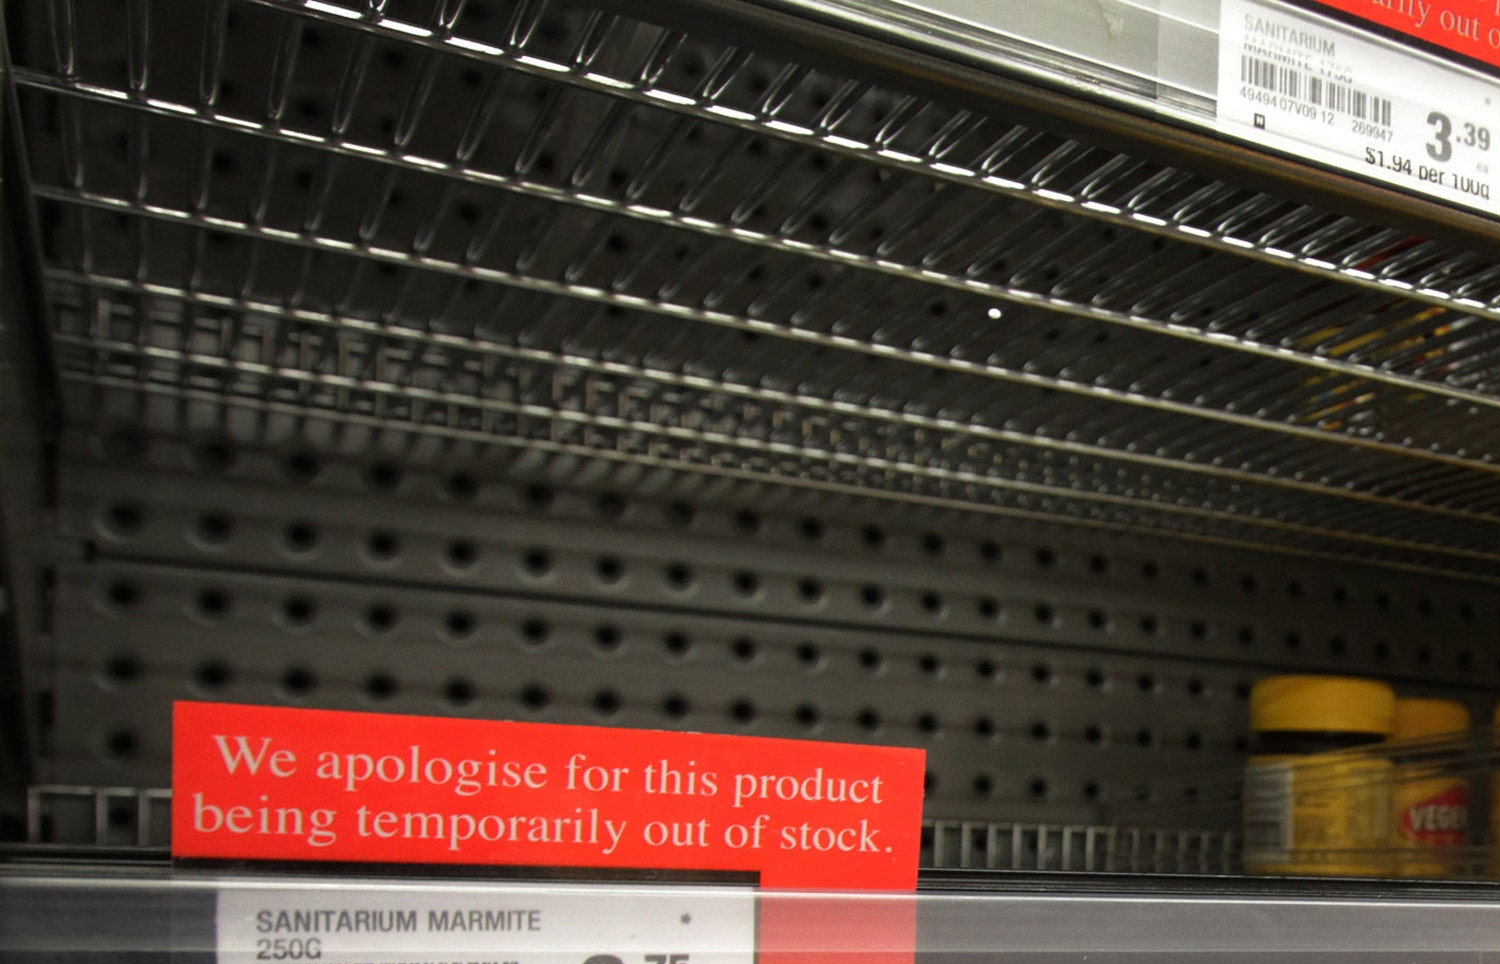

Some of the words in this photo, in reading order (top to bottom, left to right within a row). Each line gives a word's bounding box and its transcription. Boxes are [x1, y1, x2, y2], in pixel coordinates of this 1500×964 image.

[1244, 14, 1335, 57] SANITARIUM
[1440, 12, 1480, 40] out
[1365, 146, 1412, 176] $1.94
[1418, 165, 1445, 185] per
[213, 734, 297, 777] We
[316, 745, 548, 797] apologise
[565, 754, 630, 792] for
[644, 758, 718, 796] this
[733, 768, 885, 808] product
[192, 792, 337, 847] being
[356, 805, 627, 855] temporarily
[643, 818, 710, 847] out
[724, 815, 770, 849] of
[780, 819, 893, 854] stock.
[256, 910, 418, 933] SANITARIUM
[428, 908, 541, 932] MARMITE
[256, 937, 321, 960] 250G
